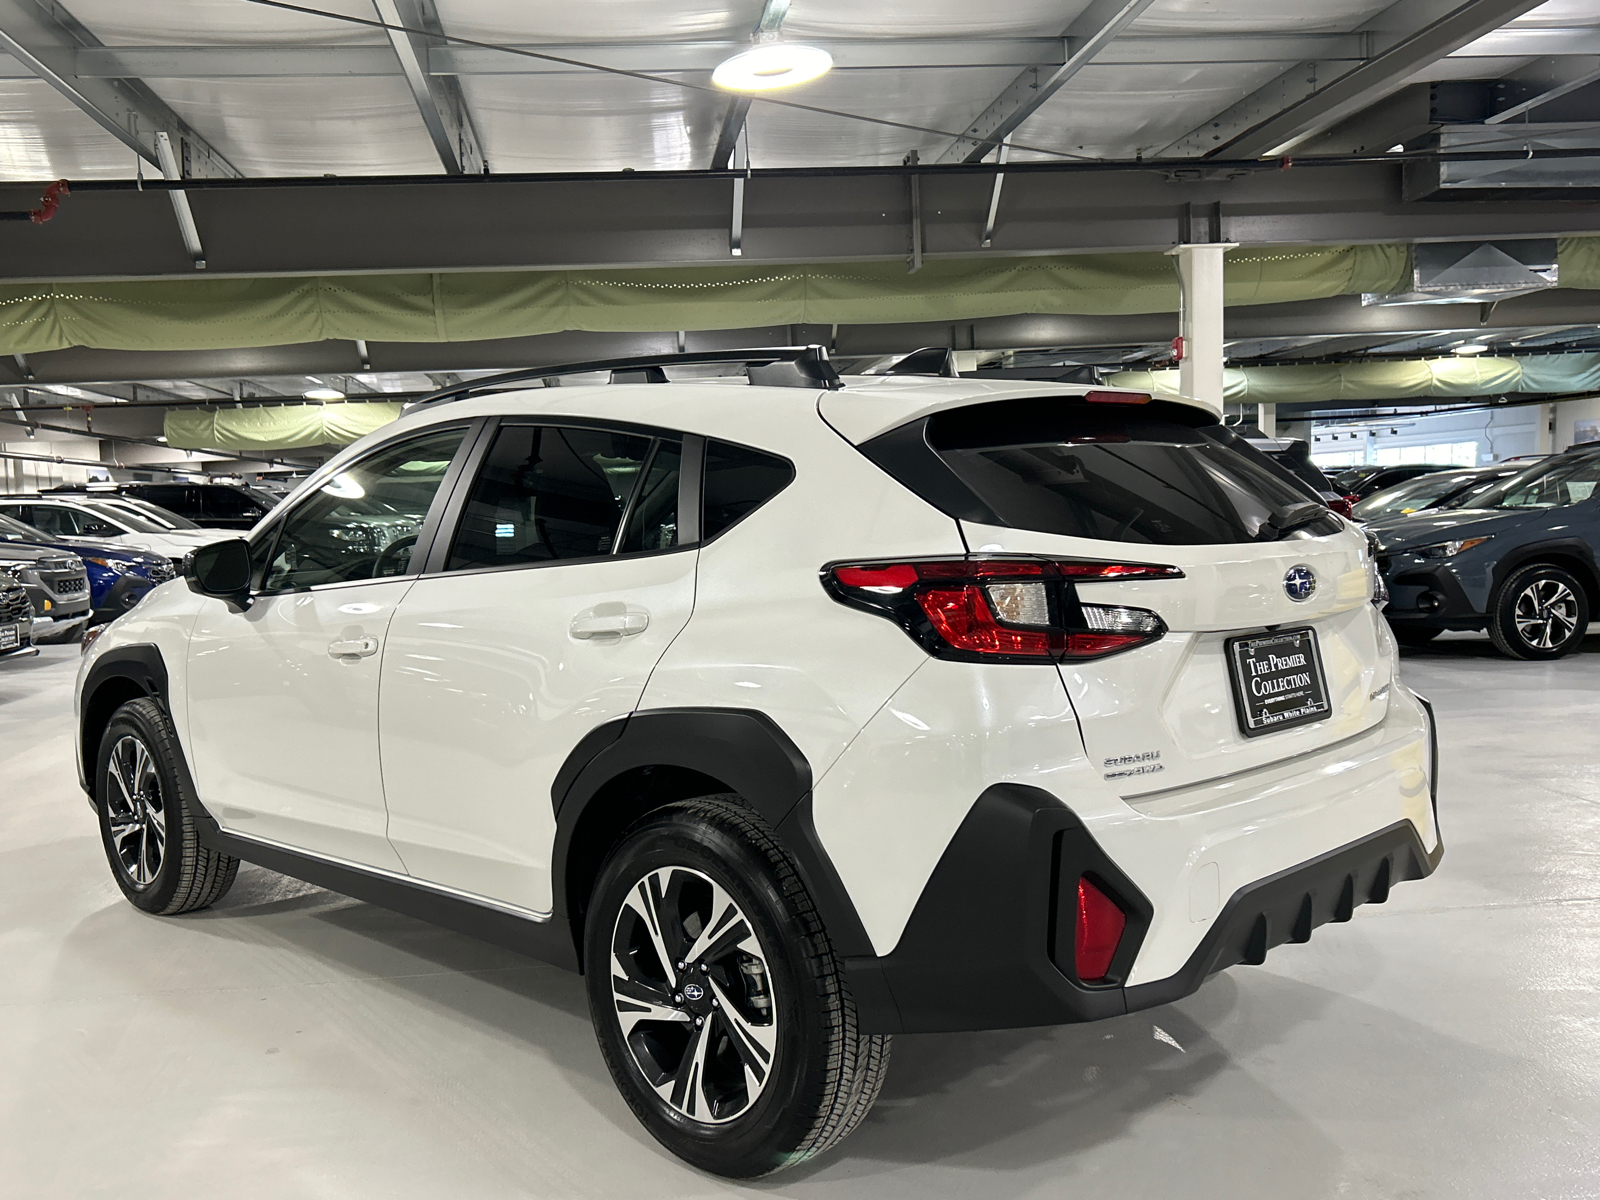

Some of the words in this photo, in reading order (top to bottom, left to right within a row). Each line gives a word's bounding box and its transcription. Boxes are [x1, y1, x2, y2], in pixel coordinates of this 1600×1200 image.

[1247, 658, 1270, 676] THE
[1269, 653, 1306, 672] PREMIER
[1251, 672, 1311, 696] COLLECTION
[1262, 714, 1283, 724] Subaru
[1283, 709, 1300, 720] White
[1300, 706, 1317, 716] Plains
[1104, 751, 1160, 767] SUBARU
